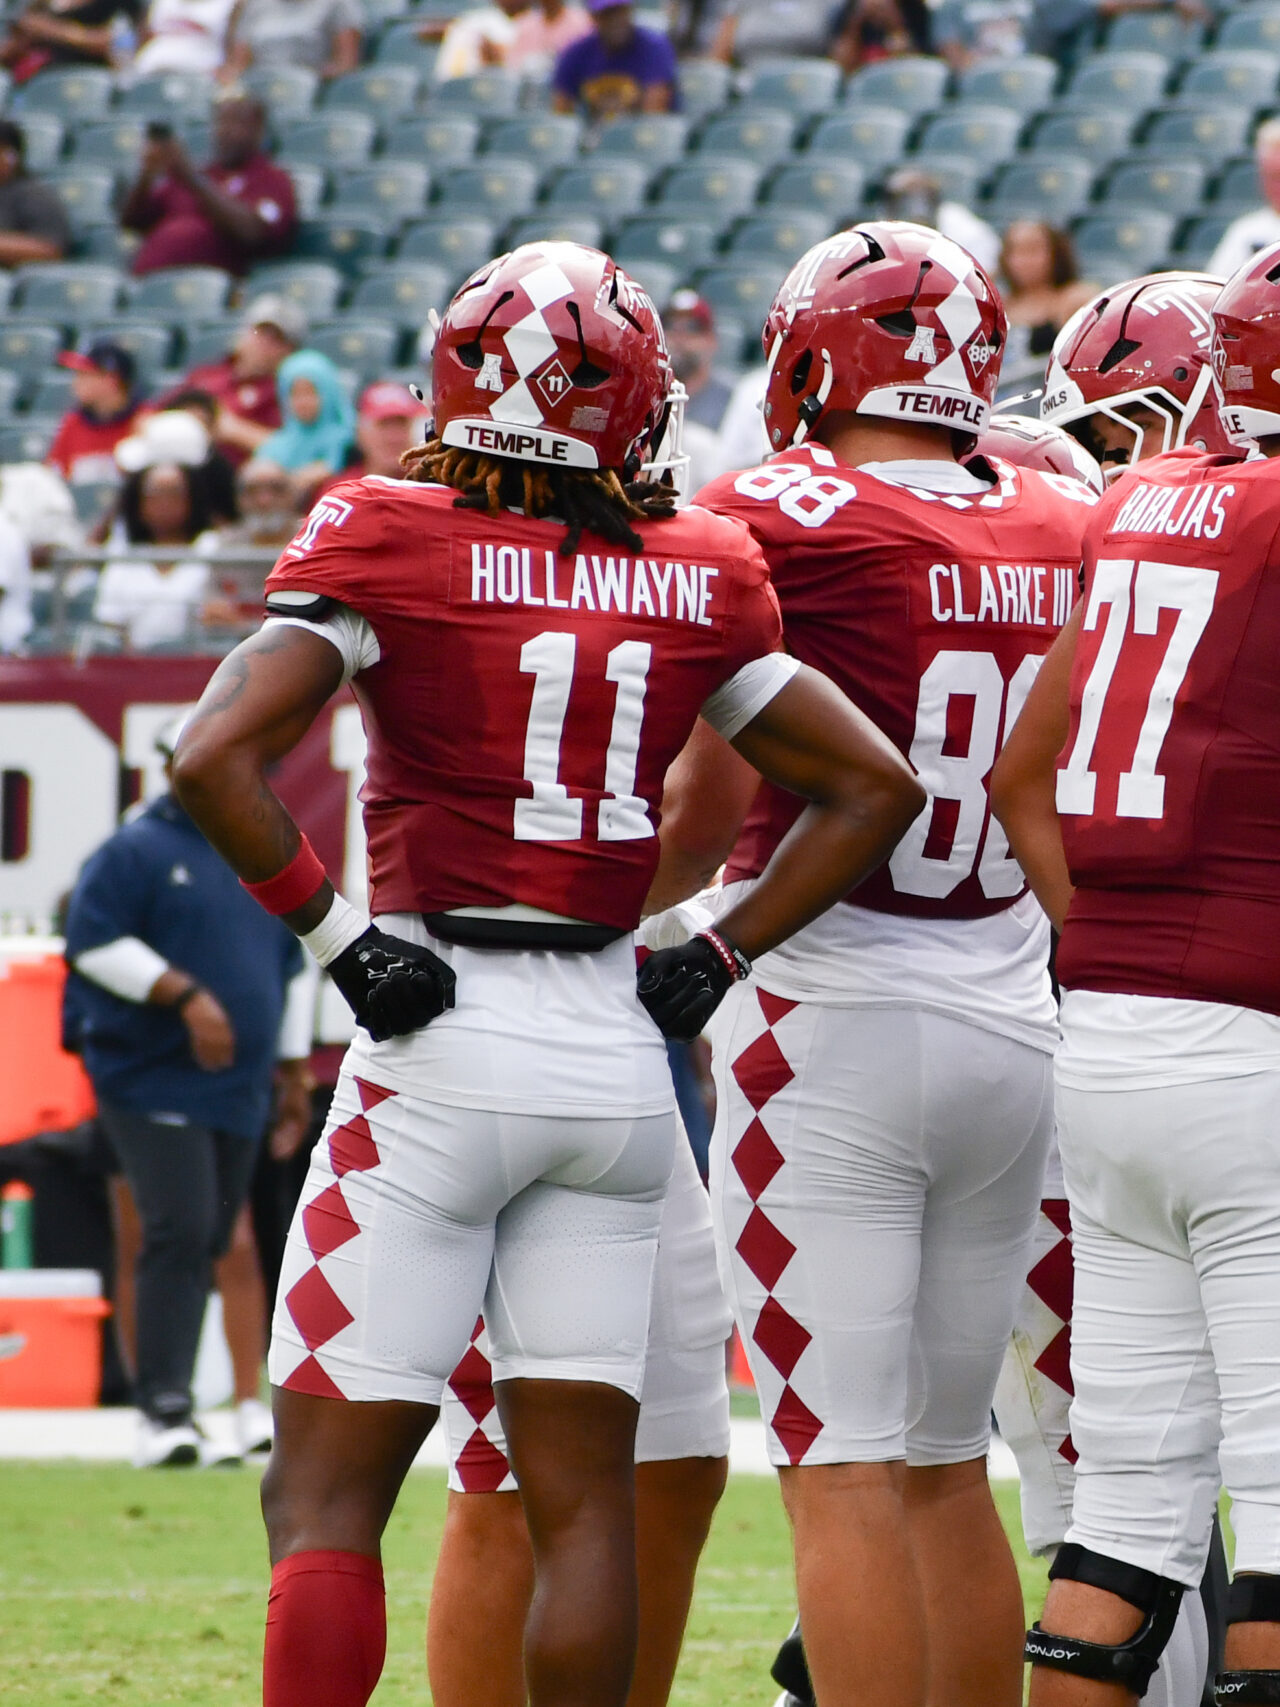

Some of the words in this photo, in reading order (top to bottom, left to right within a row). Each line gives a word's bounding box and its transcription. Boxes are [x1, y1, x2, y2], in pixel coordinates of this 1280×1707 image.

[969, 346, 990, 364] 88
[547, 375, 563, 392] 11
[896, 391, 984, 426] TEMPLE
[1042, 391, 1068, 415] OWLS
[464, 425, 568, 461] TEMPLE
[1222, 414, 1246, 435] LE
[734, 463, 857, 528] 88
[1037, 470, 1101, 507] 8
[286, 495, 354, 559] T
[1111, 484, 1235, 539] BARAJAS
[471, 543, 719, 627] HOLLAWAYNE
[928, 563, 1047, 626] CLARKE
[1053, 567, 1073, 627] III
[1055, 558, 1220, 819] 77
[514, 631, 655, 841] 11
[1025, 1642, 1078, 1660] DONJOY
